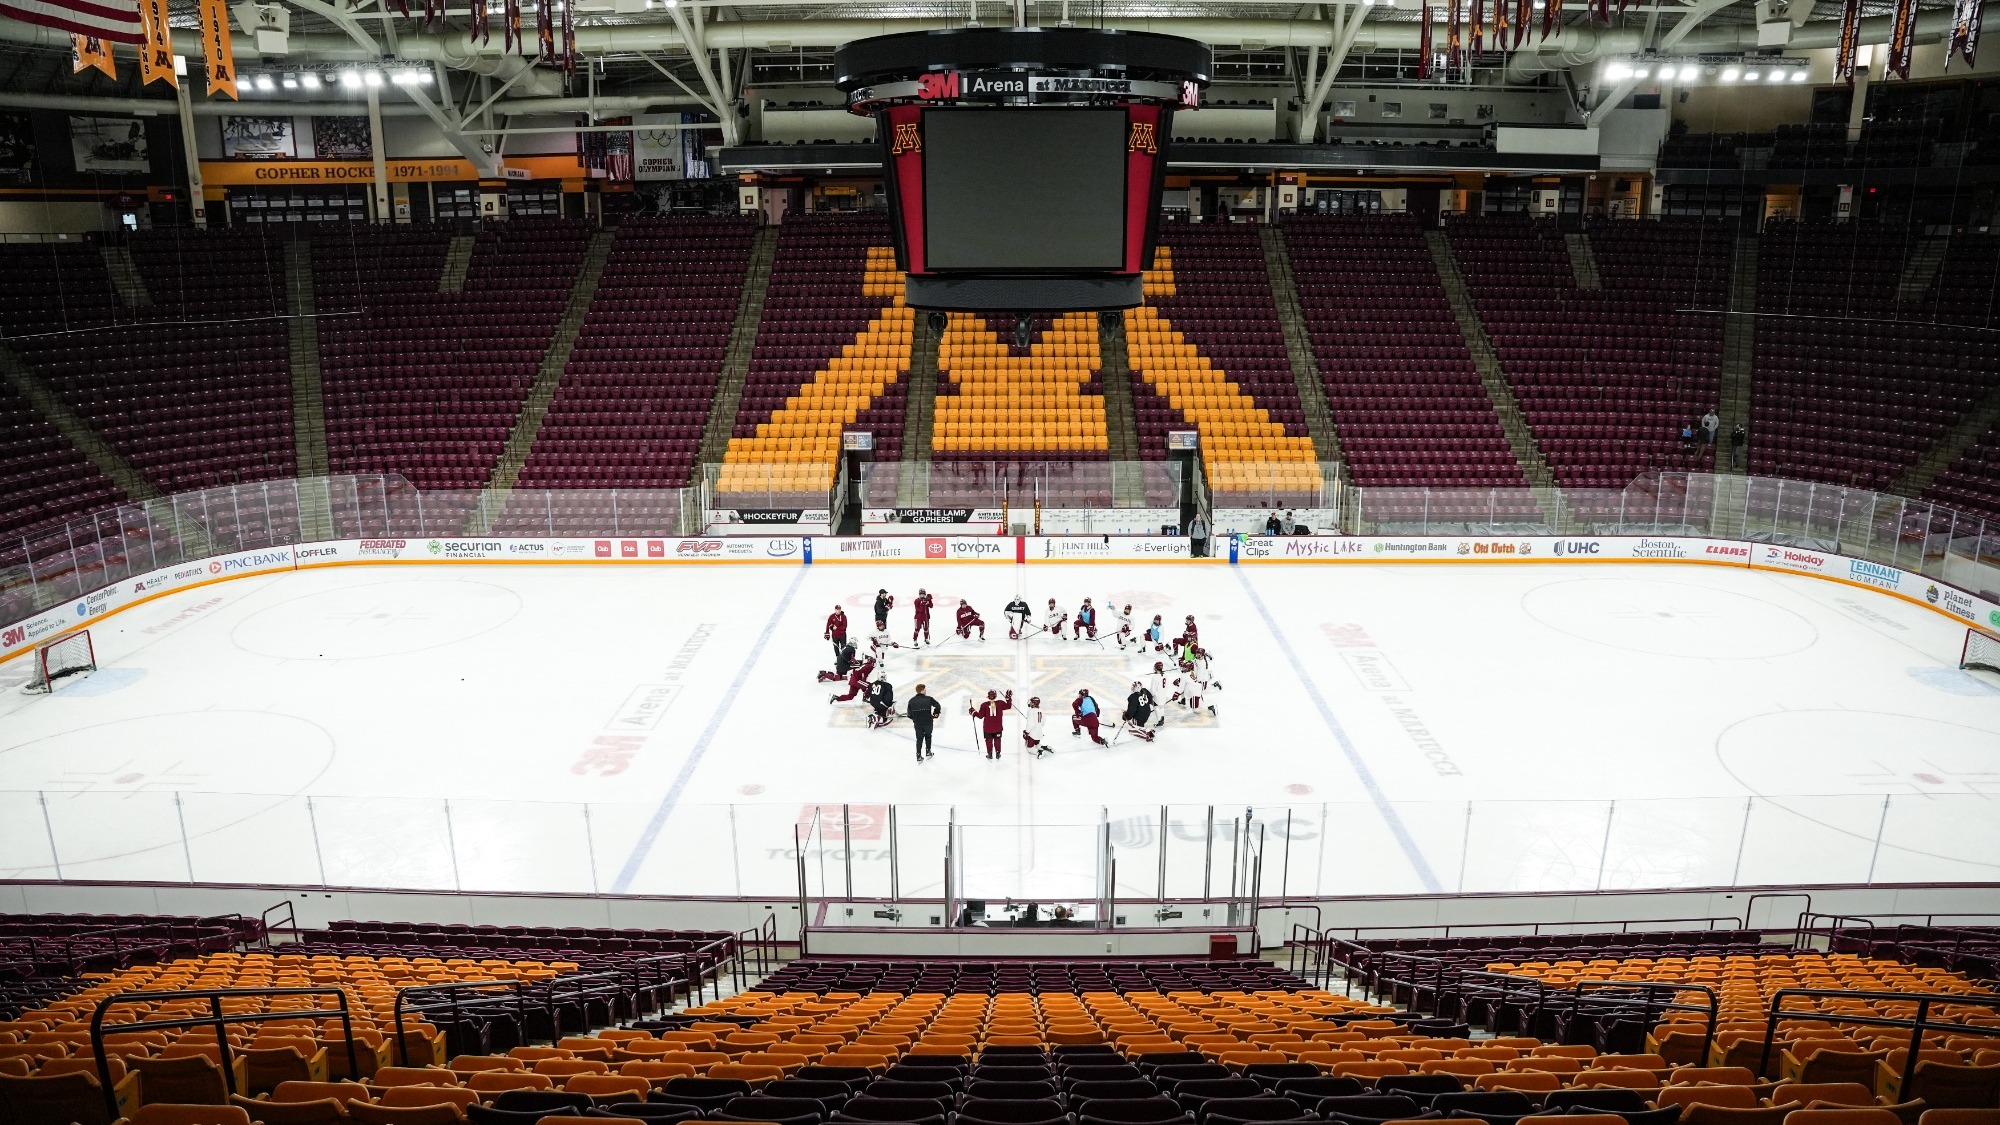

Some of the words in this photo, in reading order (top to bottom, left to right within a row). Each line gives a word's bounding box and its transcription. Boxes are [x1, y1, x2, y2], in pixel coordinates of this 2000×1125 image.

[152, 0, 164, 46] 974
[212, 5, 223, 61] 1940
[1841, 11, 1852, 66] 1993
[918, 70, 959, 99] 3M
[973, 77, 1024, 93] Arena
[1036, 79, 1049, 91] at
[1054, 79, 1132, 93] MARIUCCI
[1183, 80, 1198, 107] 3M
[892, 123, 921, 155] M
[1129, 123, 1157, 155] M
[255, 167, 320, 180] GOPHER
[325, 166, 388, 178] HOCKE
[943, 510, 967, 518] LAMP,
[360, 540, 406, 549] FEDERATED
[445, 540, 501, 552] securian
[676, 541, 723, 553] FVP
[770, 540, 795, 551] CHS
[840, 540, 882, 552] DINKYTOWN
[951, 543, 1000, 553] TOYOTA
[1144, 542, 1190, 553] Everlight
[1245, 538, 1273, 547] Great
[1385, 543, 1427, 553] Huntington
[1428, 543, 1447, 551] Bank
[1473, 542, 1489, 554] Old
[1491, 542, 1515, 554] Dutch
[1567, 542, 1600, 554] UHC
[1641, 539, 1675, 549] Boston
[296, 547, 338, 559] LOFFLER
[870, 548, 901, 557] ATHLETES
[1246, 548, 1270, 558] Clips
[1632, 546, 1687, 558] Scientific
[1706, 545, 1748, 556] CLAAS
[224, 557, 252, 571] PNC
[254, 551, 290, 566] BANK
[1784, 551, 1824, 566] Holiday
[1850, 559, 1902, 582] TENNANT
[146, 575, 168, 585] HEALTH
[1849, 573, 1899, 590] COMPANY
[86, 586, 117, 605] CenterPoint
[1944, 590, 1973, 608] planet
[89, 603, 107, 616] Energy
[1946, 601, 1976, 620] fitness
[1, 626, 25, 648] 3M
[28, 625, 49, 638] Applied
[1351, 654, 1393, 688] Arena
[872, 684, 882, 695] 30
[621, 688, 671, 725] Arena
[1170, 818, 1319, 841] UHC
[766, 848, 900, 861] TOYOTA
